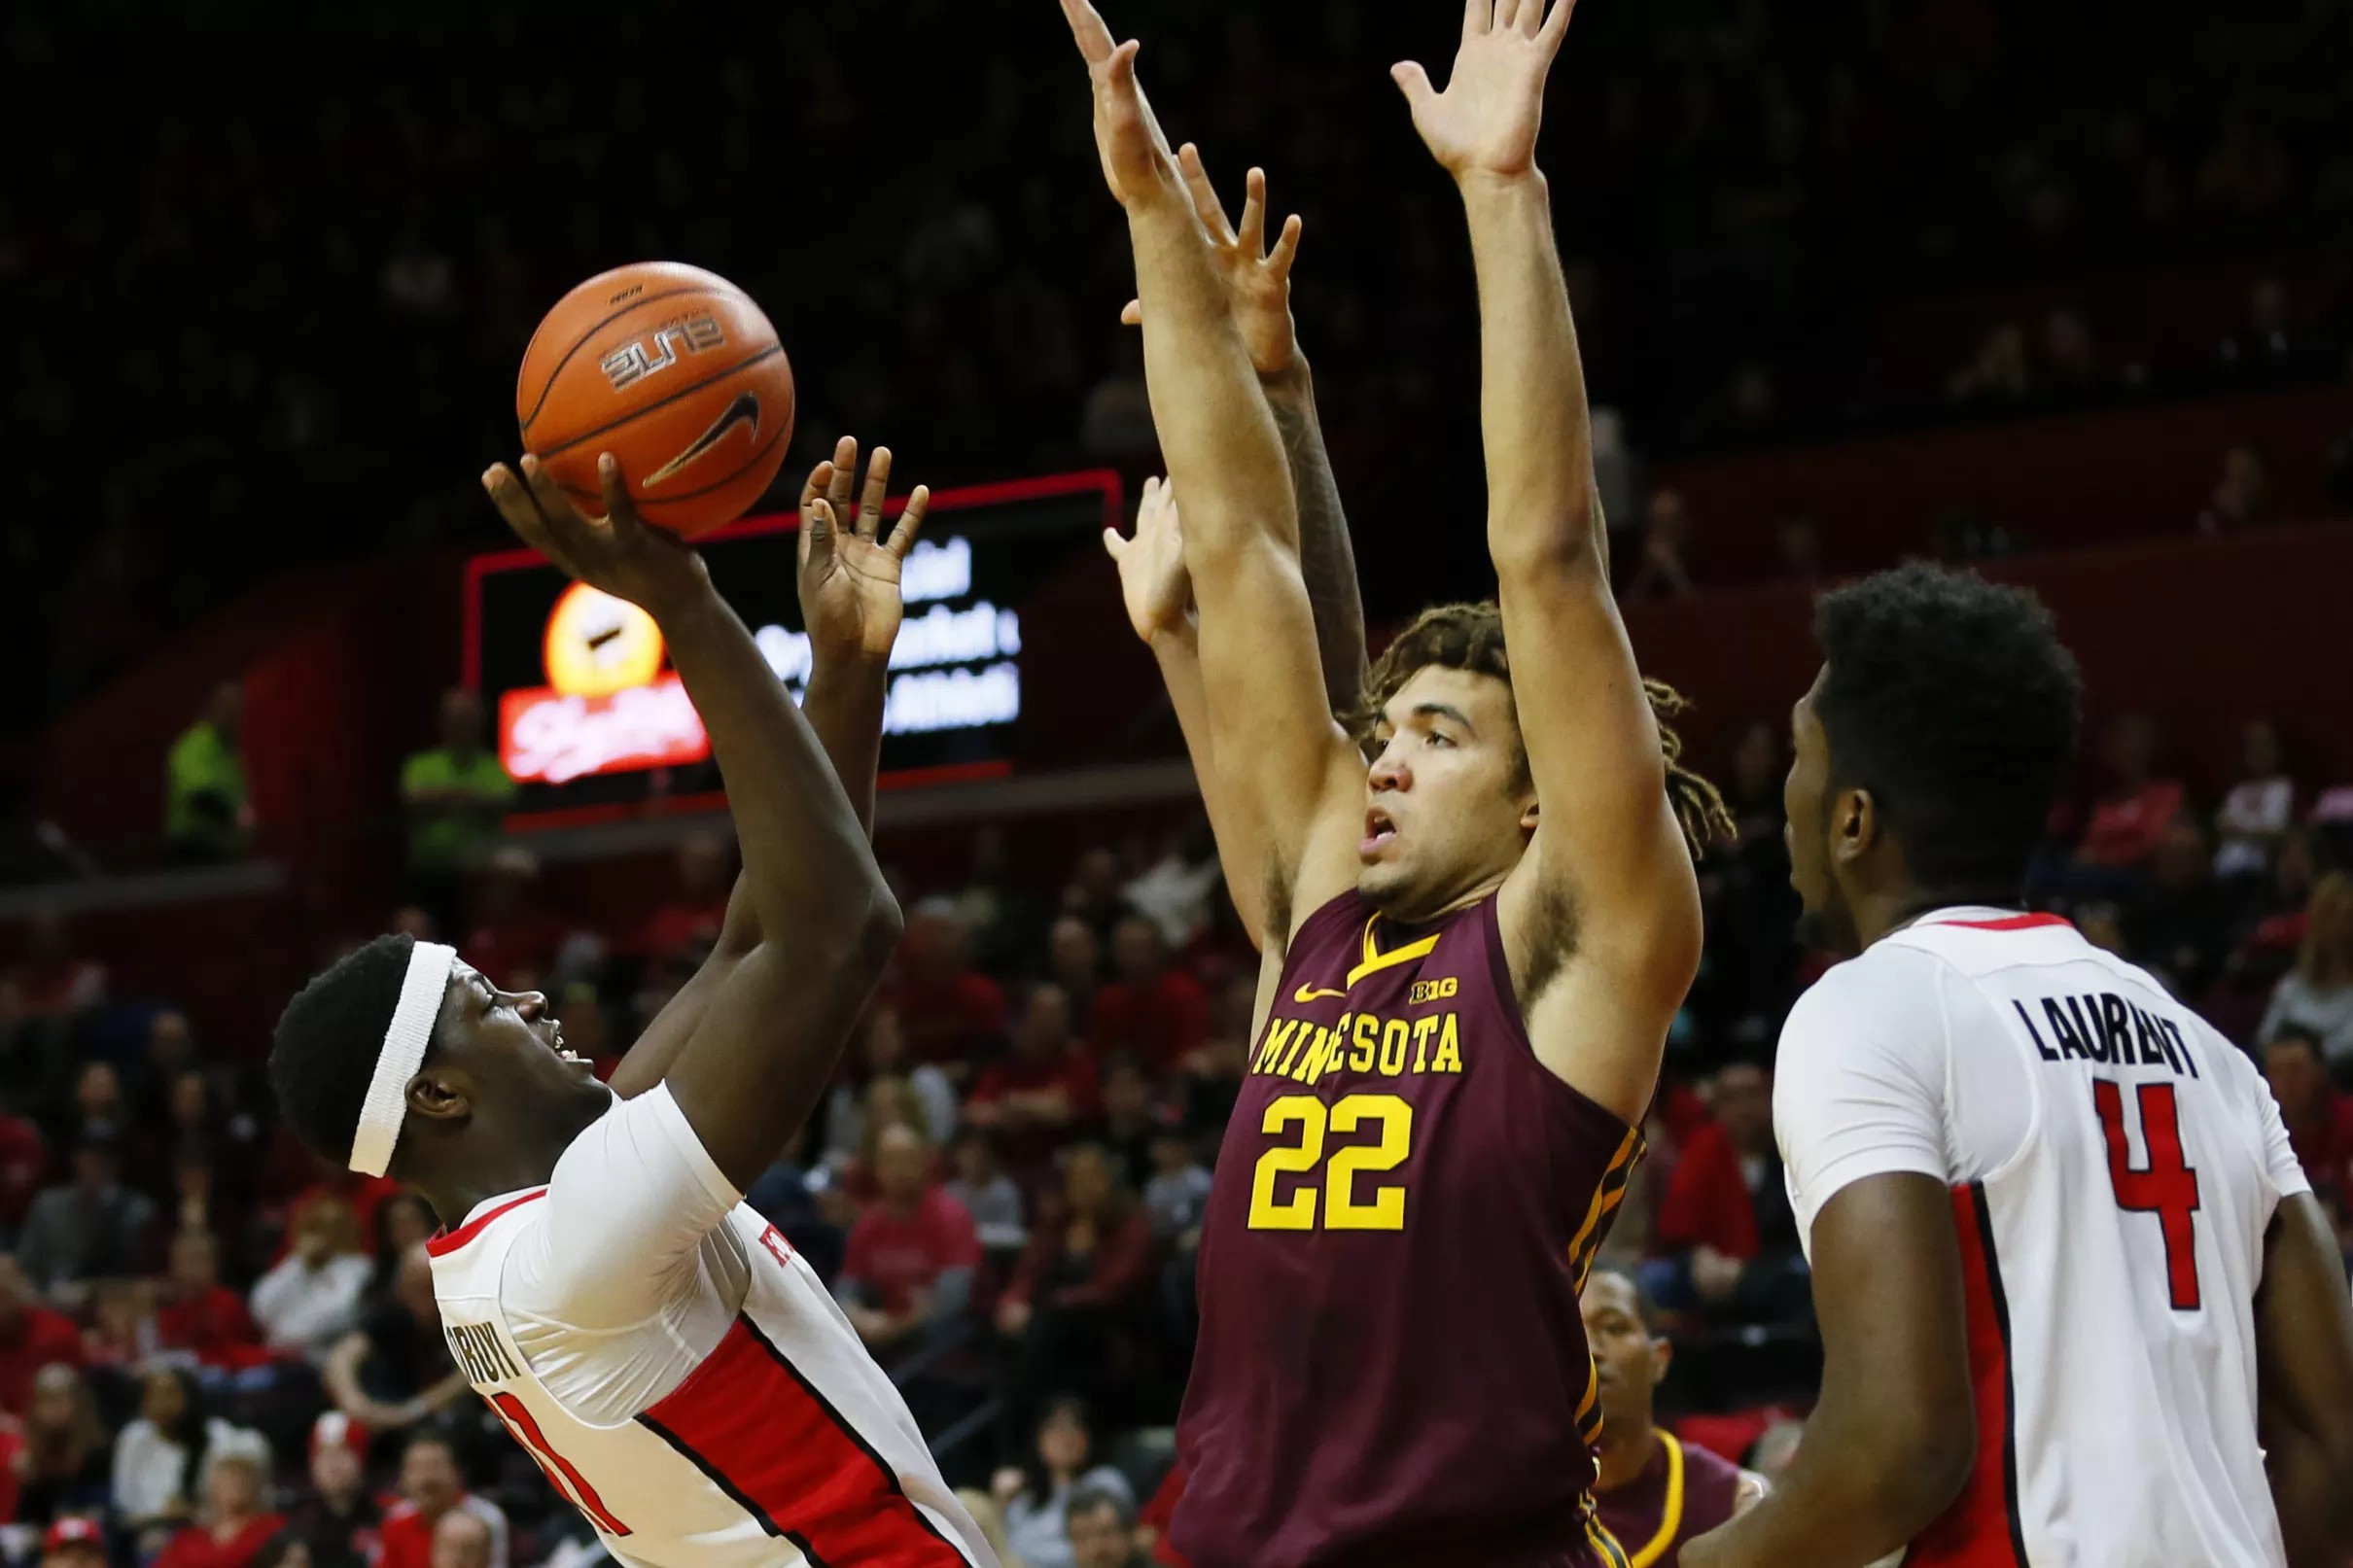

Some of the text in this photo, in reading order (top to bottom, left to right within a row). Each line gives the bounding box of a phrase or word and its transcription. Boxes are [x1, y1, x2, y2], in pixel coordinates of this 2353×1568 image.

[601, 315, 725, 393] ELITE
[1247, 1094, 1414, 1231] 22
[2092, 1075, 2200, 1310] 4
